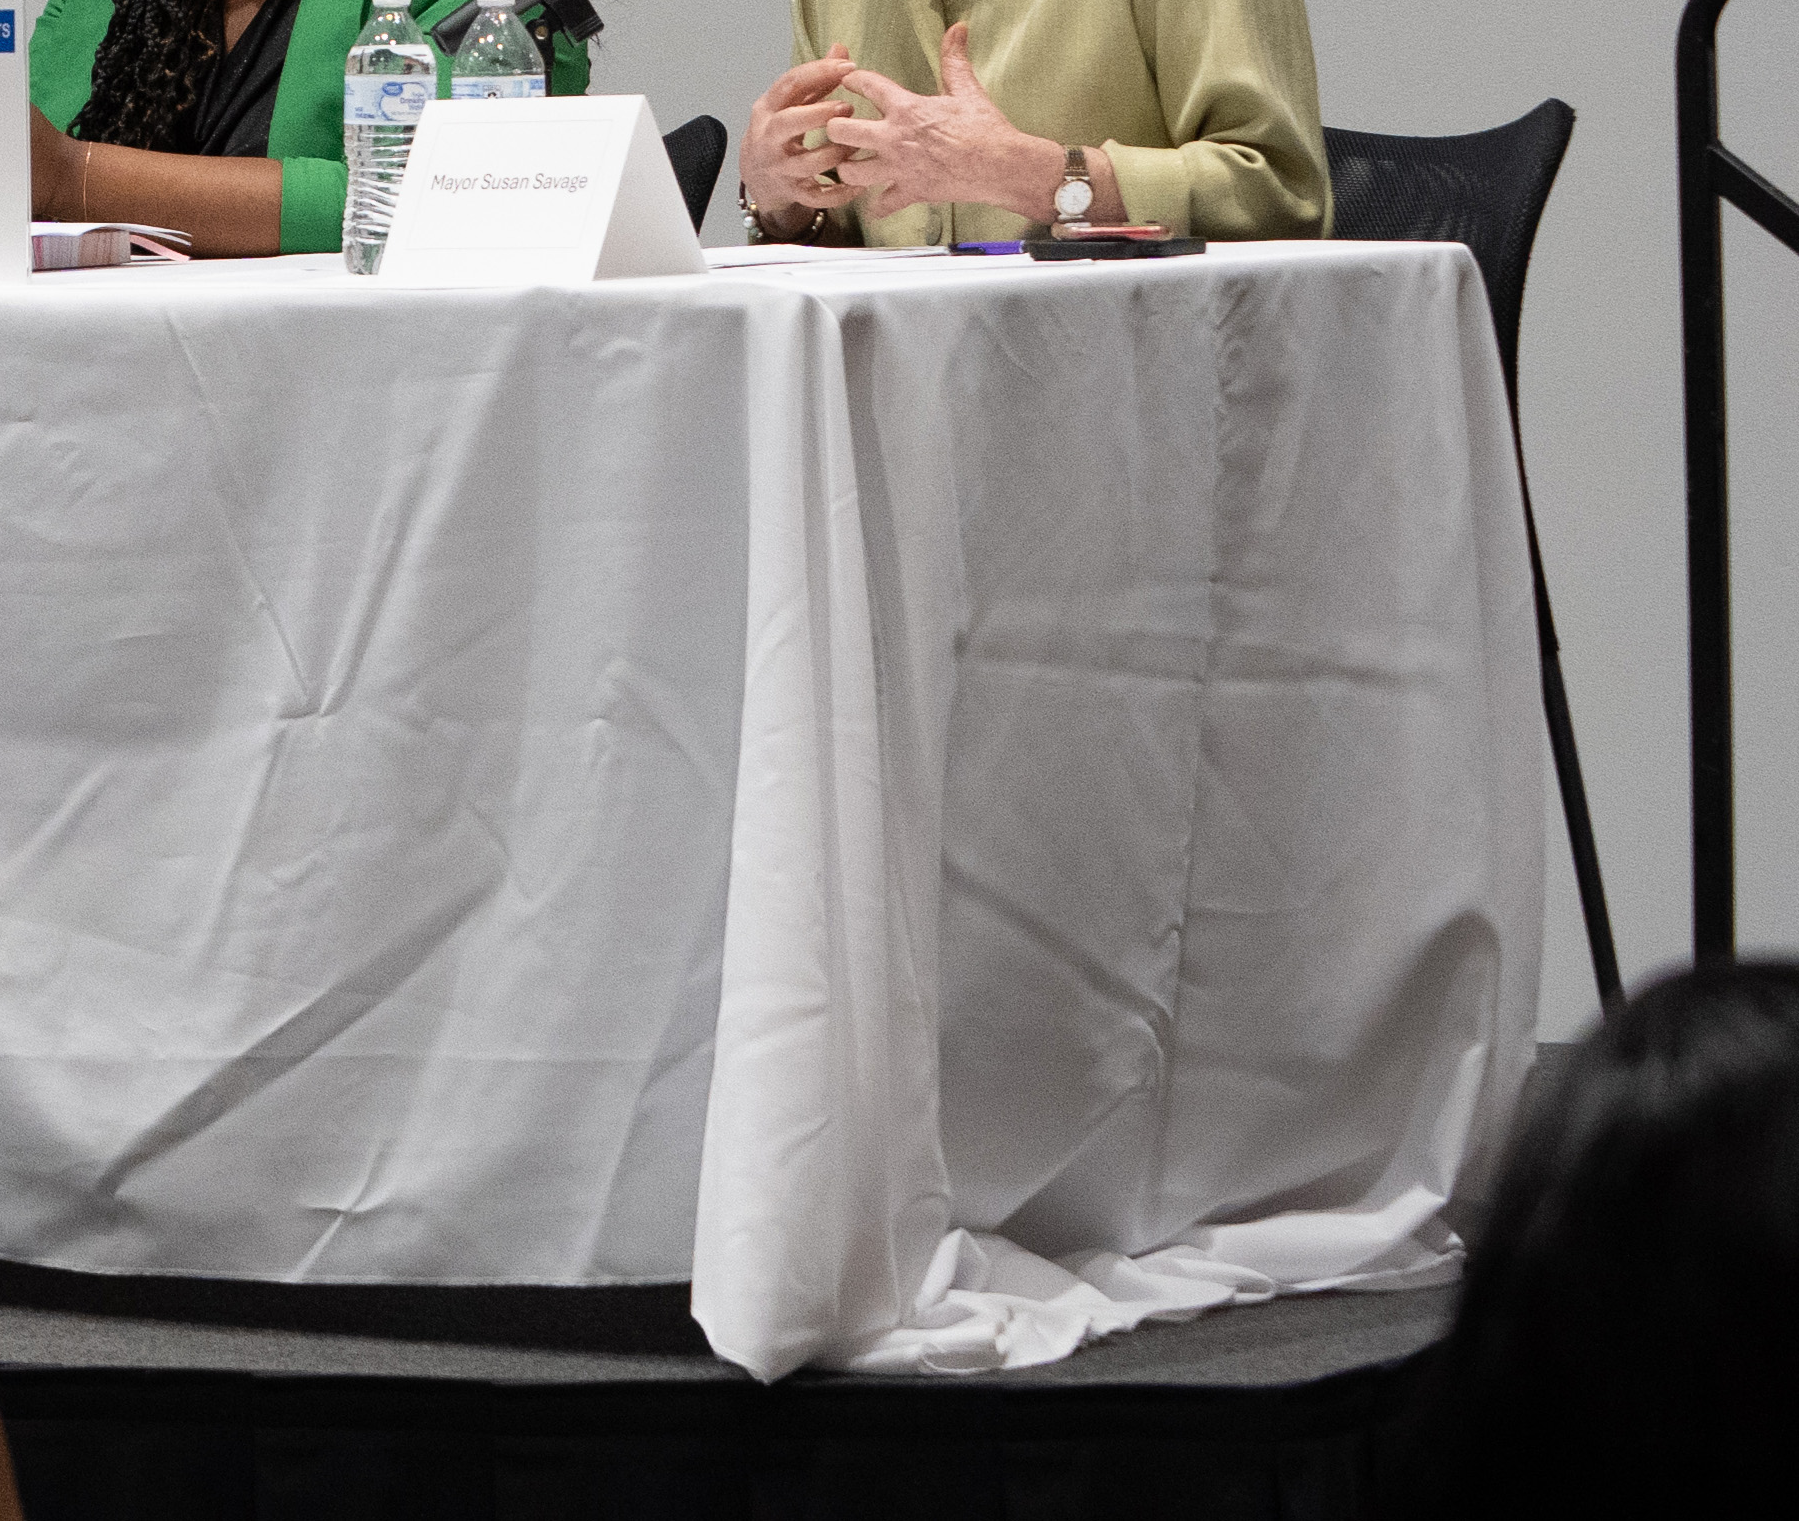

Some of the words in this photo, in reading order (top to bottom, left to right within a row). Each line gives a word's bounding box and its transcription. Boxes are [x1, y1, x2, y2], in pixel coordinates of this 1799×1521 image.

[431, 174, 478, 194] Mayor
[480, 173, 529, 190] Susan
[532, 172, 588, 193] Savage
